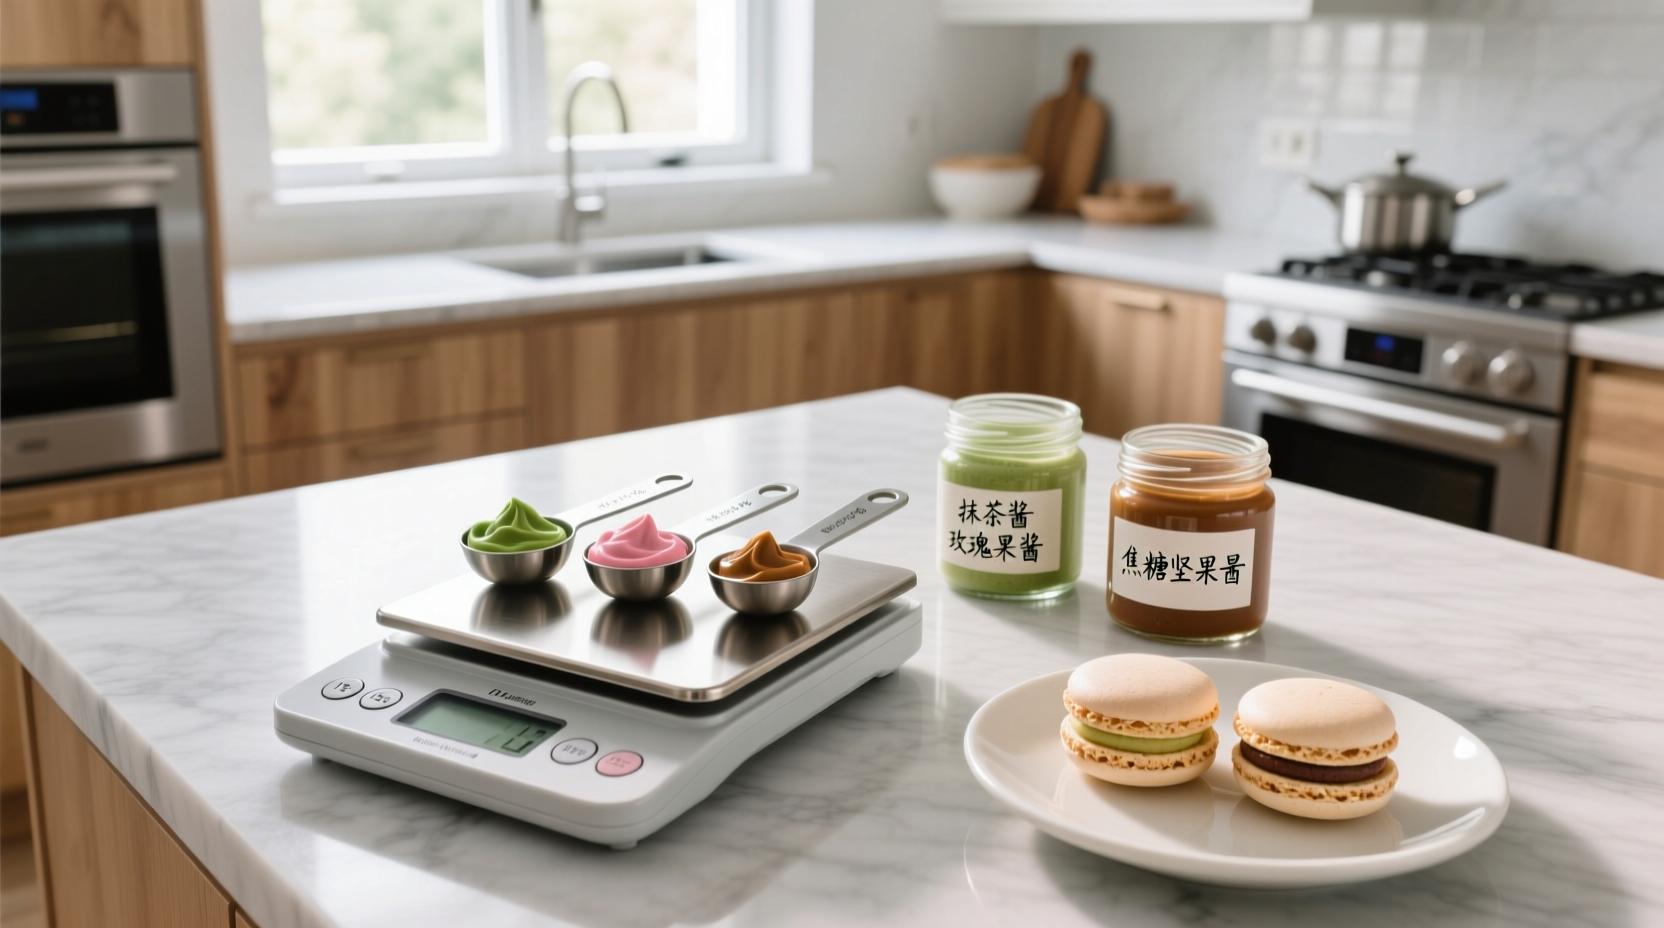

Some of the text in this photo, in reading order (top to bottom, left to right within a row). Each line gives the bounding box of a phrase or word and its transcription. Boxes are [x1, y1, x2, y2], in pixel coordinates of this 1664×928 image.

[958, 498, 1035, 529] 抹茶酱
[948, 529, 1044, 563] 玫瑰果酱
